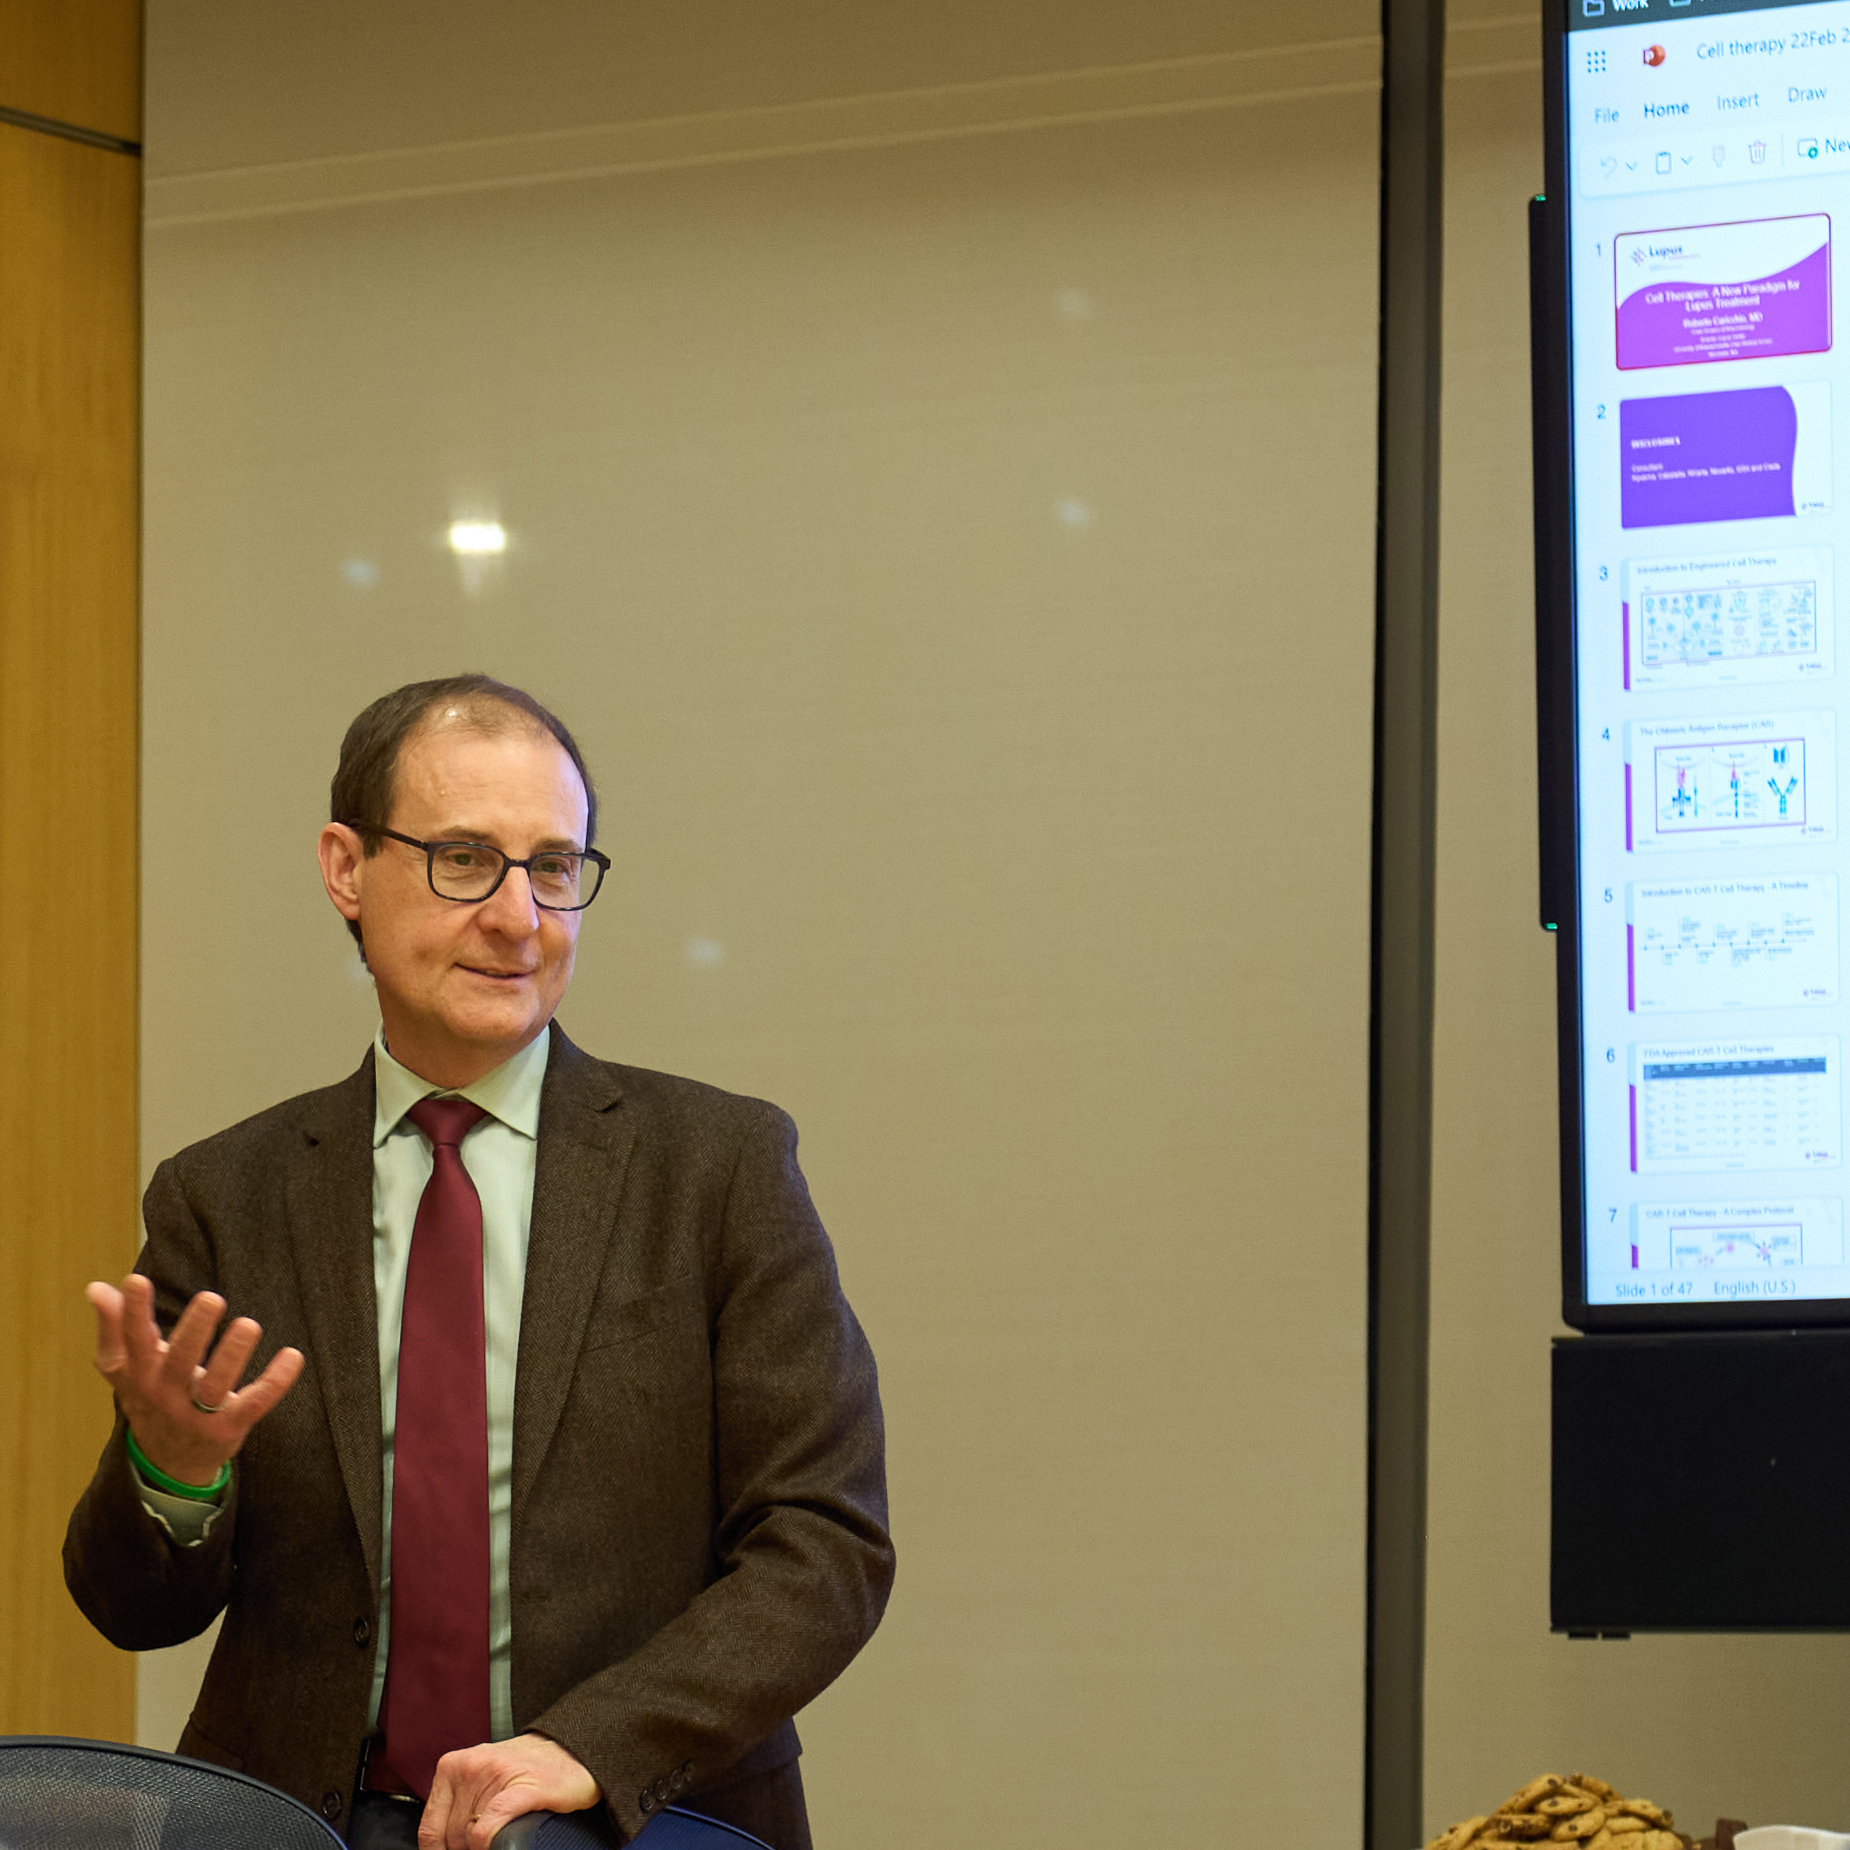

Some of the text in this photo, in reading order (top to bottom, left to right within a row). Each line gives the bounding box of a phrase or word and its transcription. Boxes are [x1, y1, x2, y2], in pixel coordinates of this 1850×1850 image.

[1697, 41, 1725, 60] Cell
[1729, 37, 1787, 56] therapy
[1790, 28, 1837, 49] 22Feb
[1717, 91, 1760, 111] Insert
[1788, 86, 1828, 103] Draw
[1594, 106, 1620, 124] File
[1643, 101, 1690, 120] Home
[1597, 404, 1606, 419] 2
[1599, 565, 1609, 581] 3
[1601, 727, 1610, 741] 4
[1604, 887, 1613, 903] 5
[1606, 1047, 1615, 1063] 6
[1608, 1207, 1617, 1223] 7
[1615, 1283, 1646, 1297] Slide
[1661, 1281, 1674, 1296] of
[1678, 1281, 1693, 1295] 47
[1714, 1279, 1796, 1298] English (U.S.)
